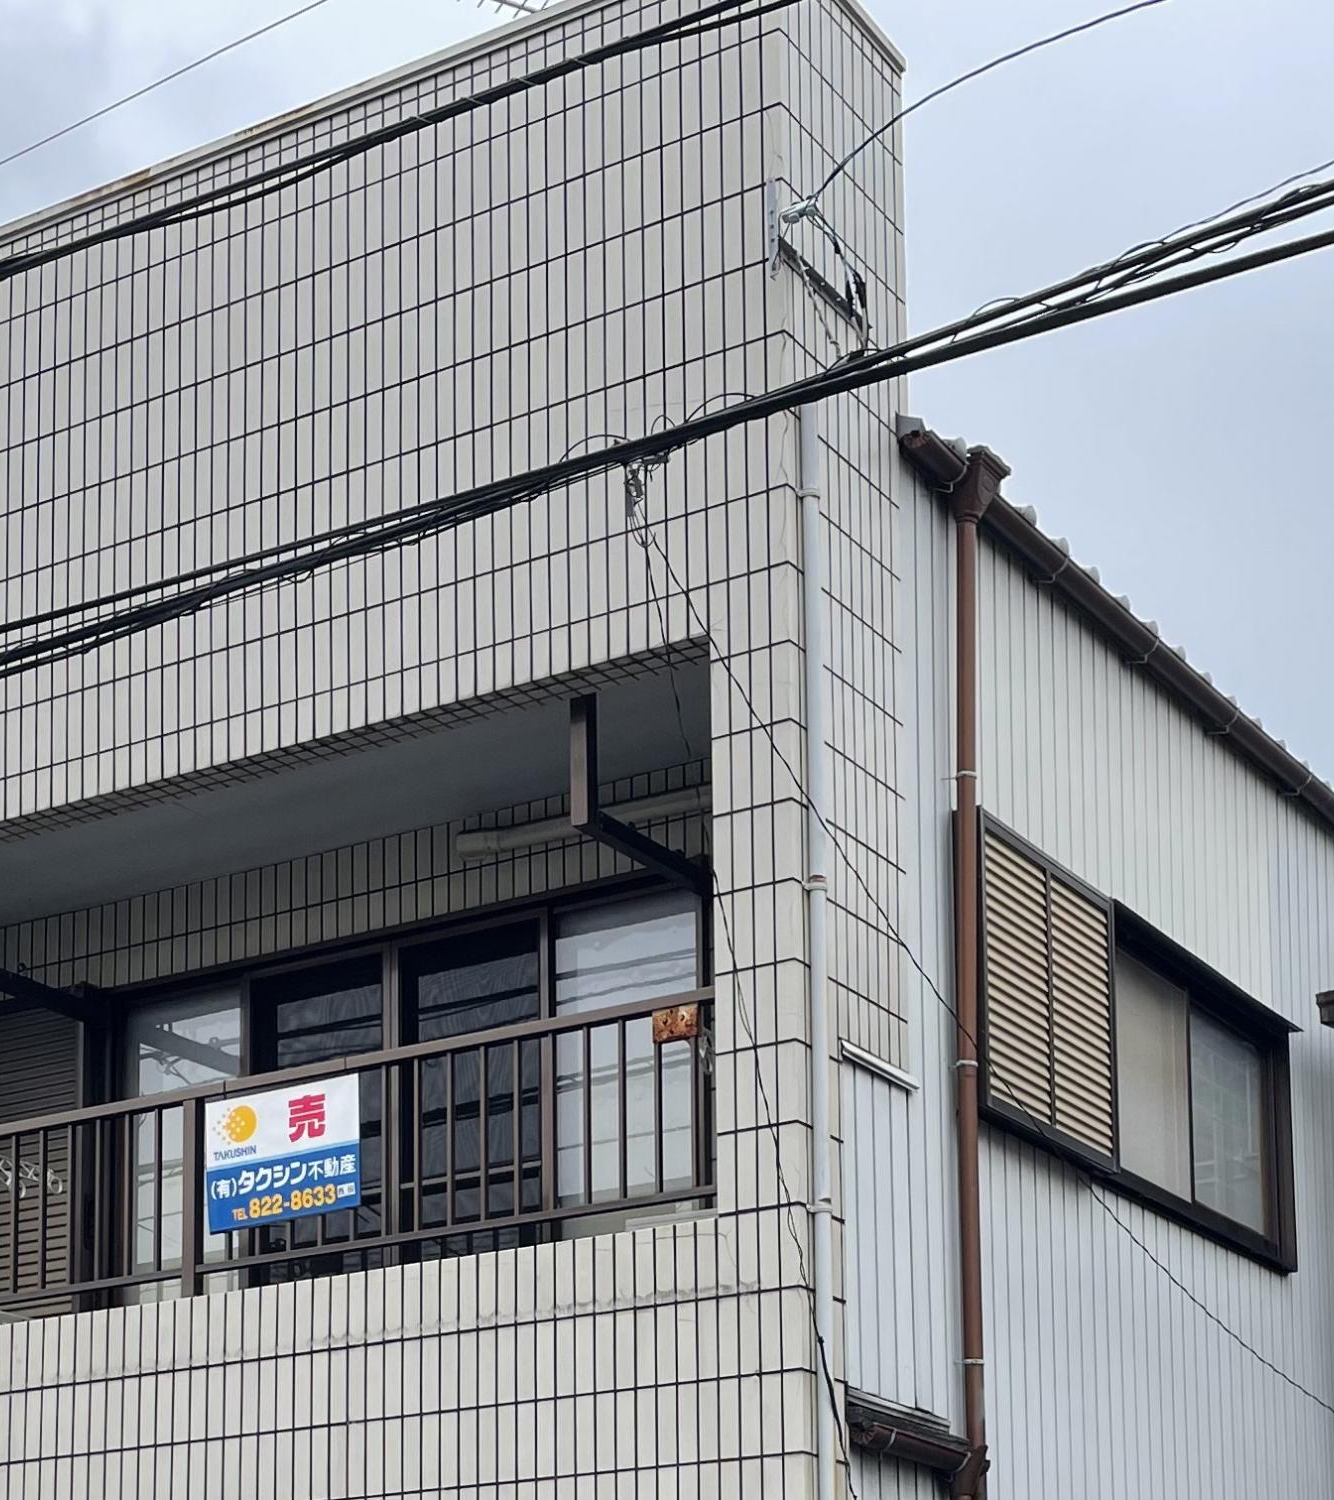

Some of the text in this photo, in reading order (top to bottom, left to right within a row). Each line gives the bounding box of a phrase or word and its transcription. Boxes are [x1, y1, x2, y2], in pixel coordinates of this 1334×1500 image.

[288, 1093, 326, 1143] 売
[213, 1145, 257, 1161] TAKUSHIN
[210, 1154, 356, 1200] (有)タクシン不動産
[249, 1184, 336, 1219] 822-8633
